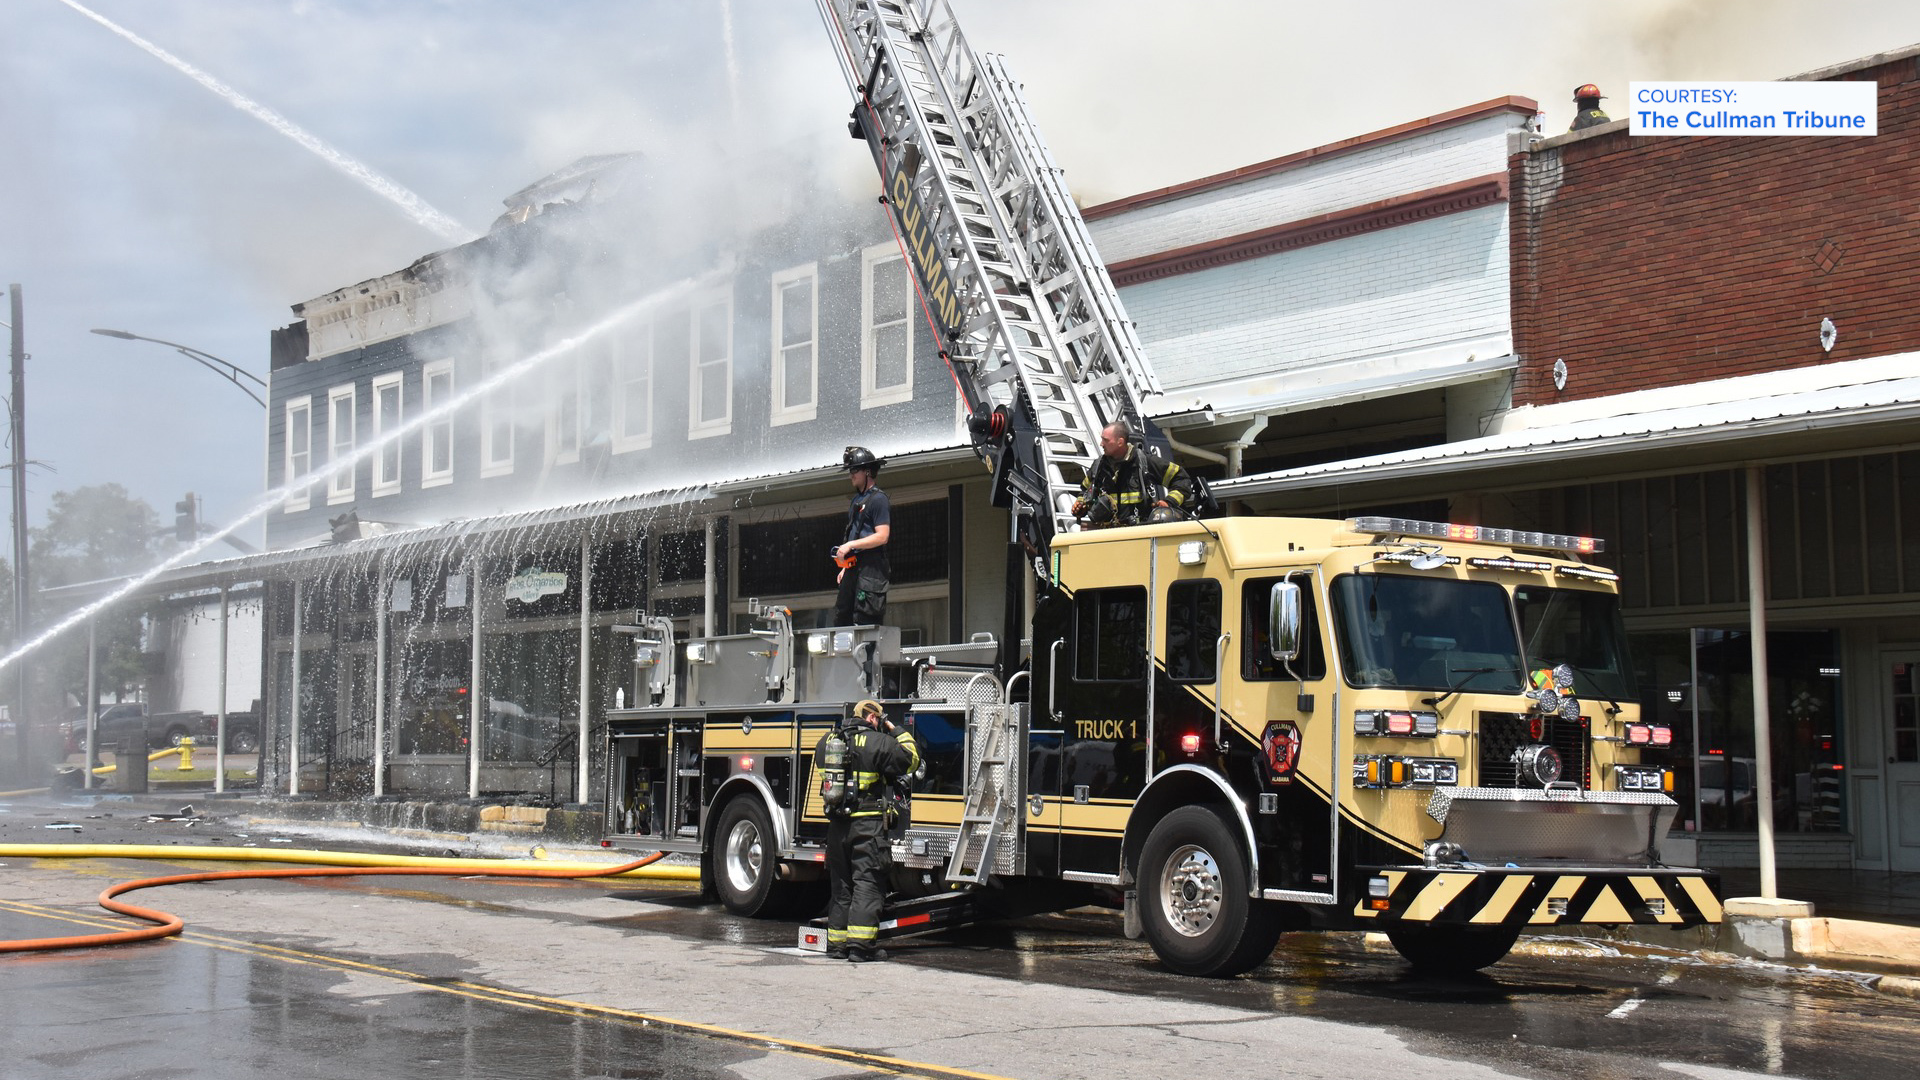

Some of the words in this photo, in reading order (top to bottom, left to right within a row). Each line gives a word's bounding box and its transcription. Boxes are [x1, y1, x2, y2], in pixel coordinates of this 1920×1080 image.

[893, 170, 962, 328] CULLMAN
[1075, 719, 1124, 739] TRUCK
[1129, 719, 1137, 739] 1
[1271, 723, 1291, 731] CULLMAN
